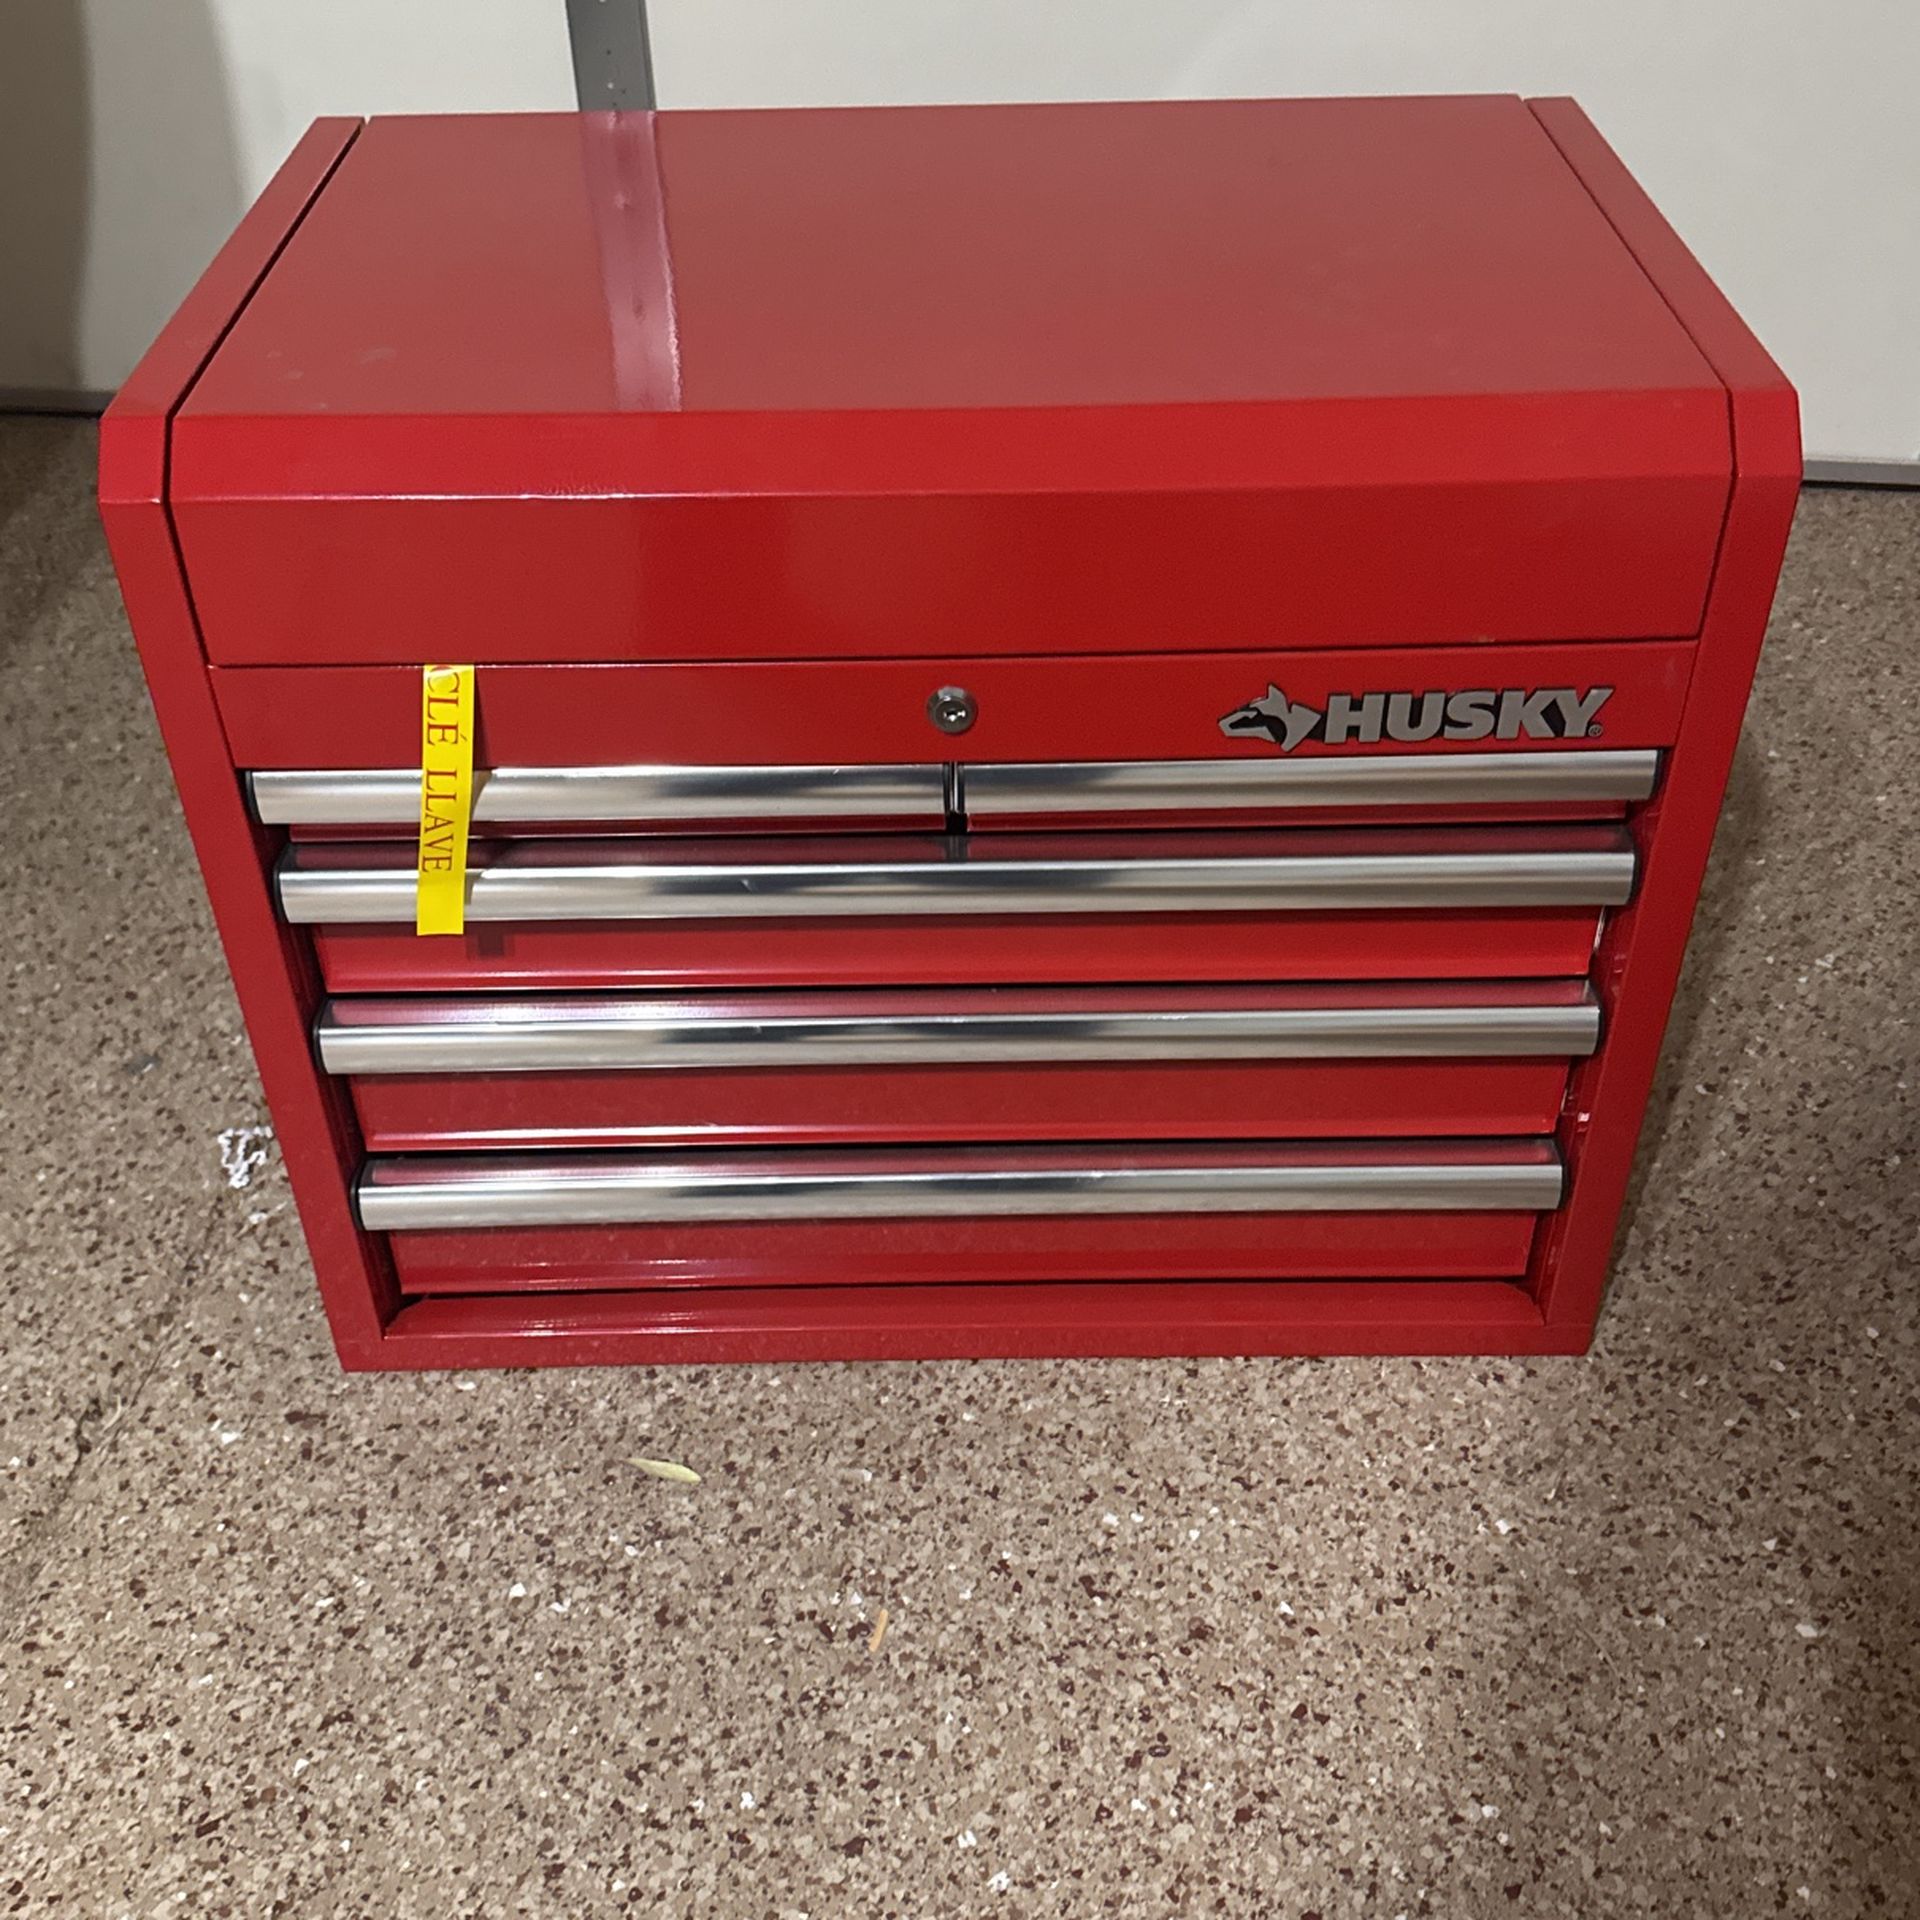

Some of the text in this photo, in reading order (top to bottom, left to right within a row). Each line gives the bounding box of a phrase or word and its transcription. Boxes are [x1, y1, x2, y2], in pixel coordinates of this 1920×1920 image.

[422, 668, 467, 872] CLÉ LLAVE
[1324, 687, 1615, 744] HUSKY
